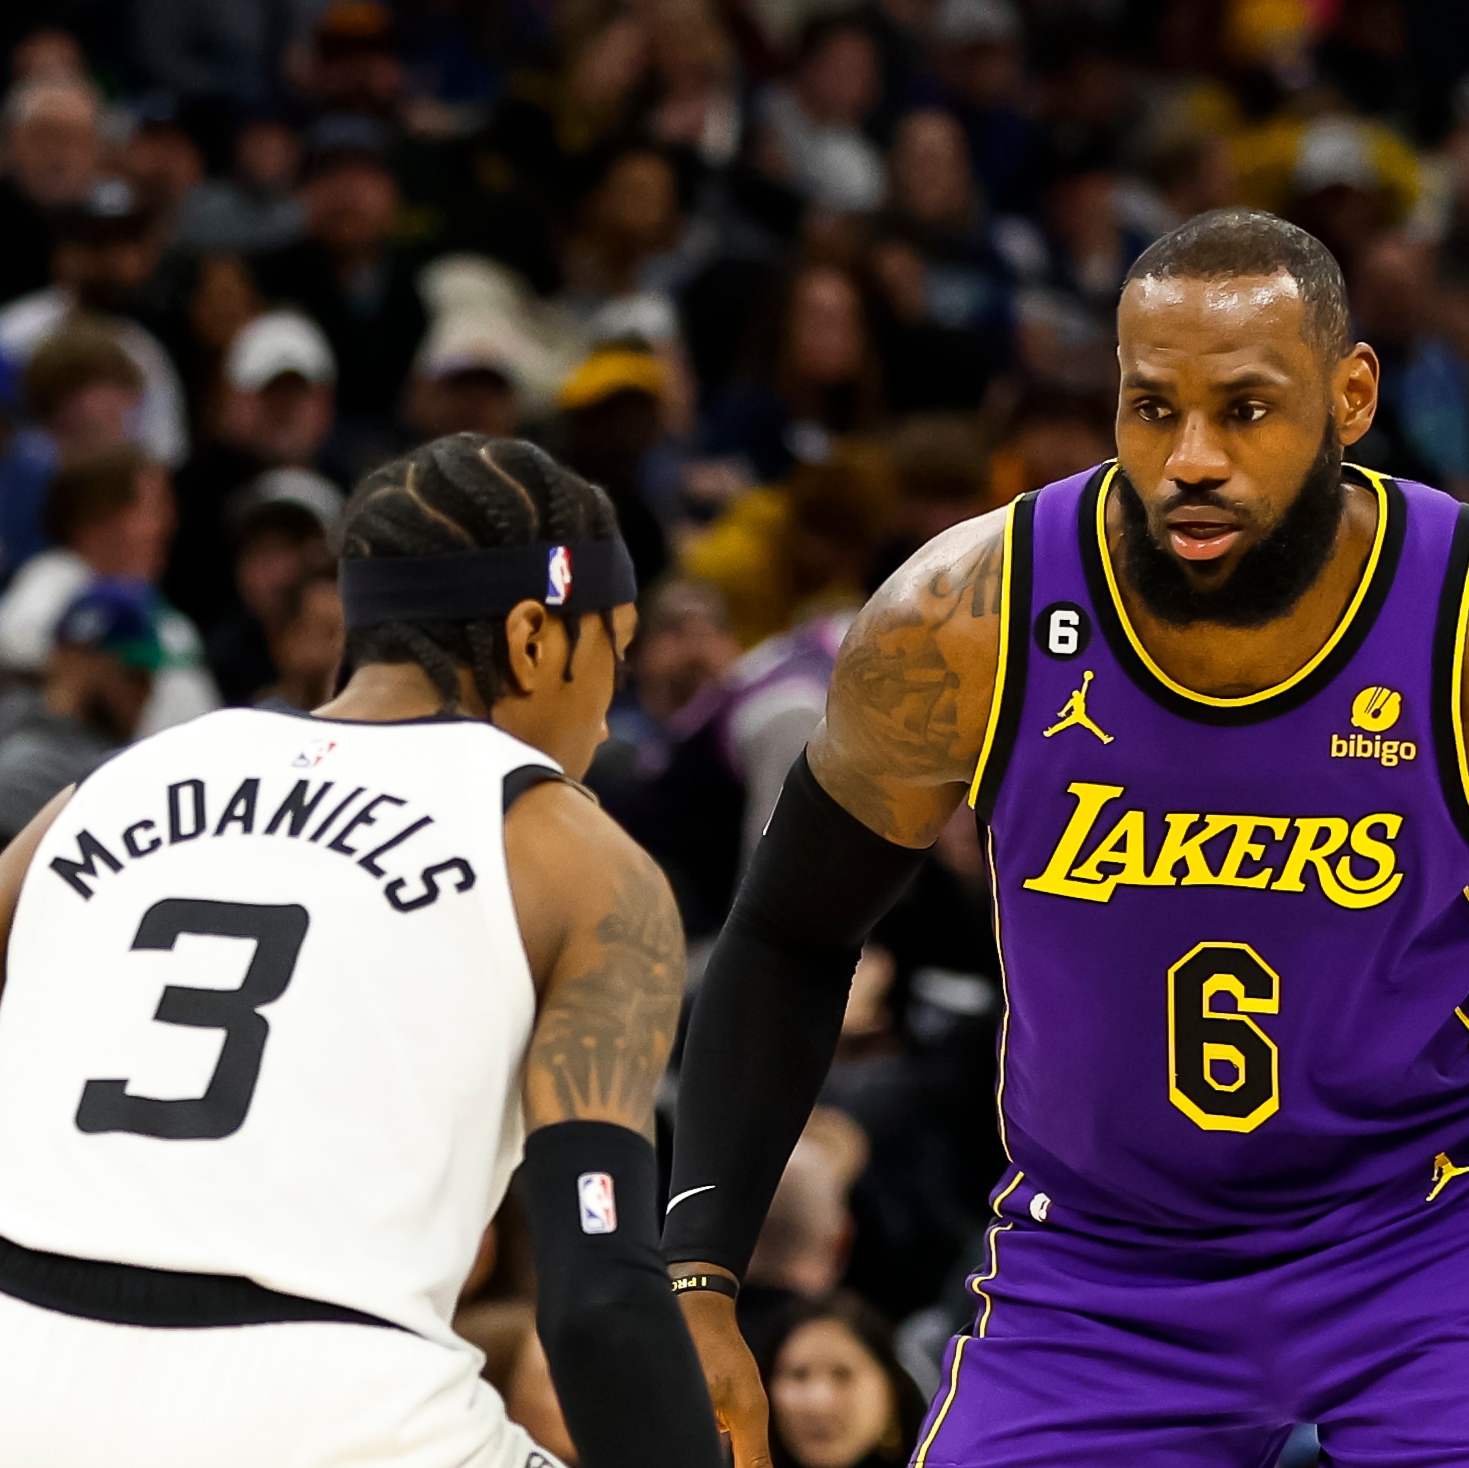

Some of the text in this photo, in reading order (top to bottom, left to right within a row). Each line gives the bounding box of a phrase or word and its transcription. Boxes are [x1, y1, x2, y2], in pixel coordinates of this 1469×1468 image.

[1048, 610, 1079, 654] 6
[1331, 734, 1416, 767] bibigo
[49, 779, 476, 913] McDANIELS
[1022, 782, 1404, 909] LAKERS
[74, 898, 309, 1139] 3
[1166, 941, 1280, 1133] 6
